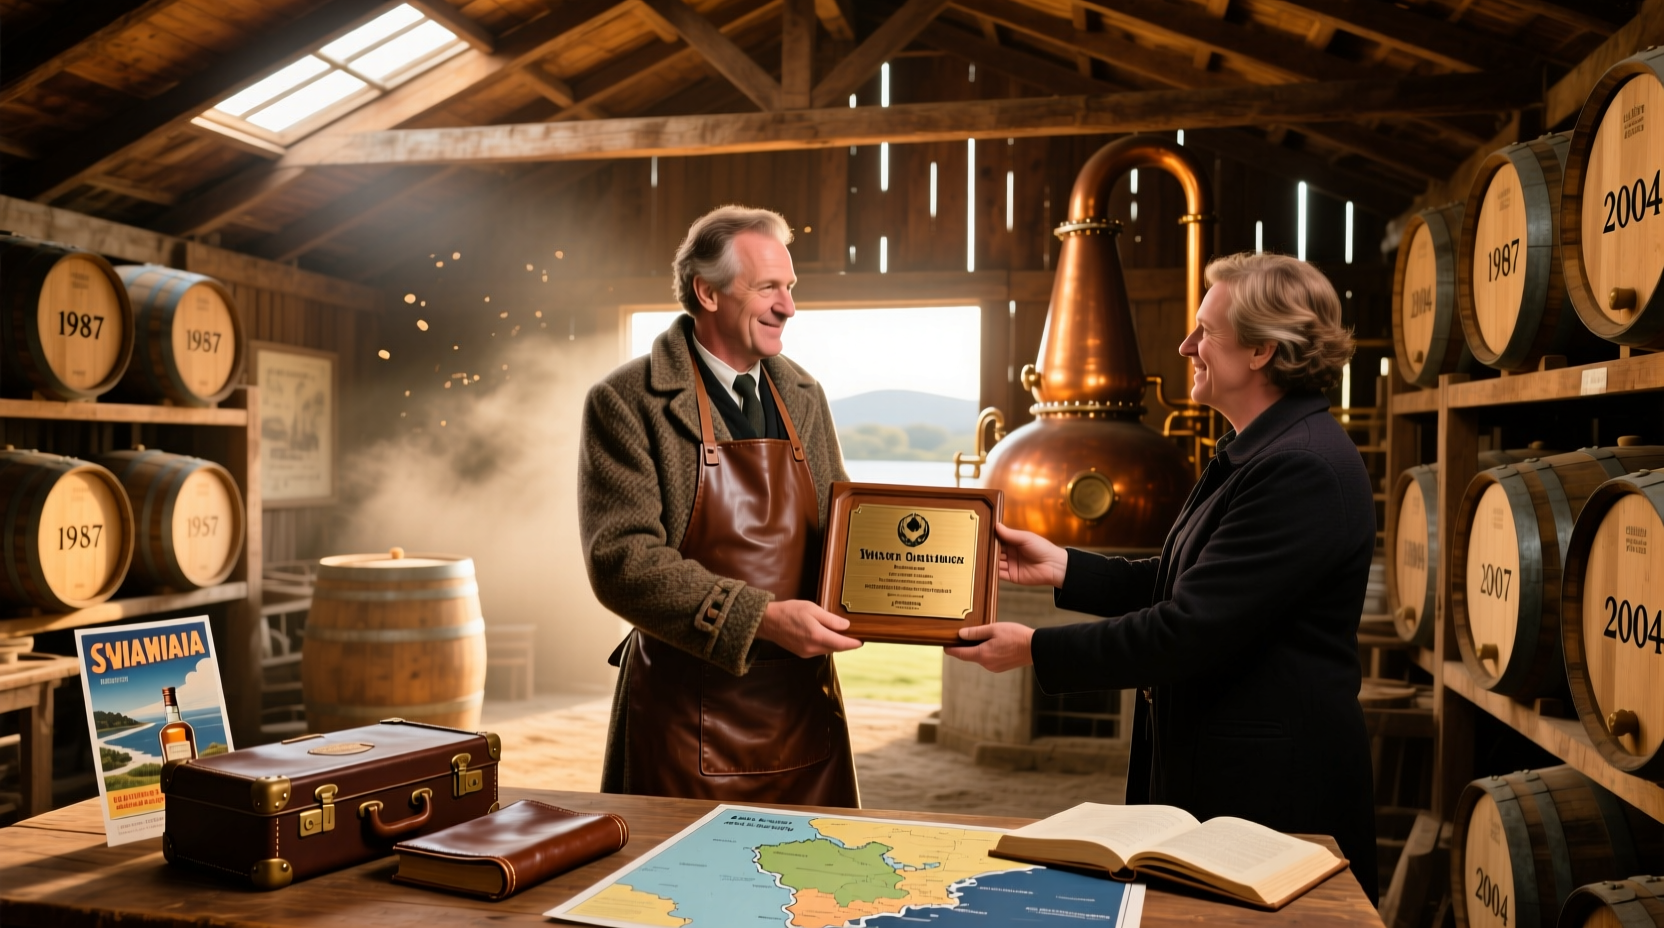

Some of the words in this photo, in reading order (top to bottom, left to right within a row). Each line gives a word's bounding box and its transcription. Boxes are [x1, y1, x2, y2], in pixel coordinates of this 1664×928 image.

[1602, 169, 1663, 234] 2004
[1488, 238, 1520, 282] 1987
[58, 310, 105, 340] 1987
[186, 329, 222, 354] 1987
[58, 524, 103, 551] 1987
[1480, 563, 1512, 602] 2007
[1603, 595, 1664, 655] 2004
[1475, 866, 1508, 928] 2004
